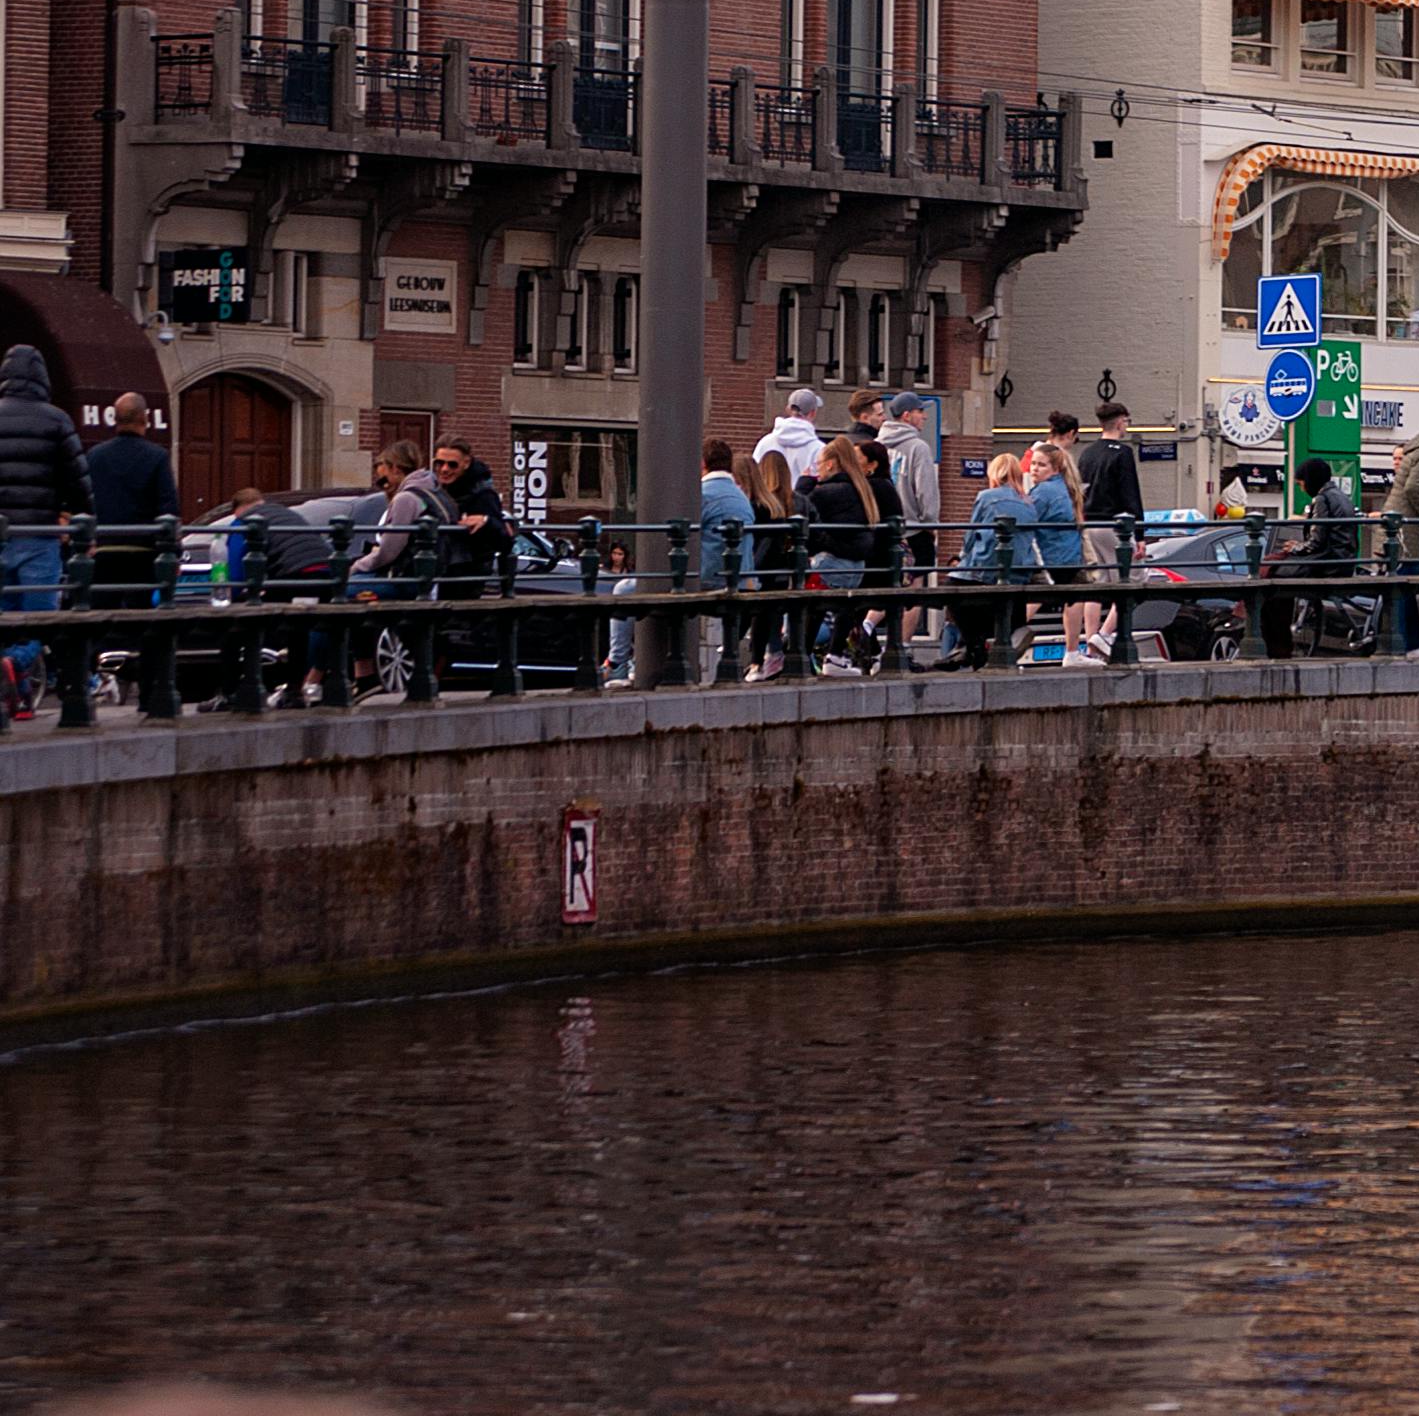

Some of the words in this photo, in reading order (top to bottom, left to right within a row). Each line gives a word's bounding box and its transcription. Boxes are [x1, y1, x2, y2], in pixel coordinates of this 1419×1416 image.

[173, 268, 245, 287] FASHION
[209, 286, 244, 303] FOR
[1316, 349, 1331, 381] P
[82, 404, 169, 430] HOL
[1360, 399, 1405, 428] NCAKE
[514, 441, 526, 471] OF
[513, 474, 526, 520] URE
[527, 441, 548, 536] HION
